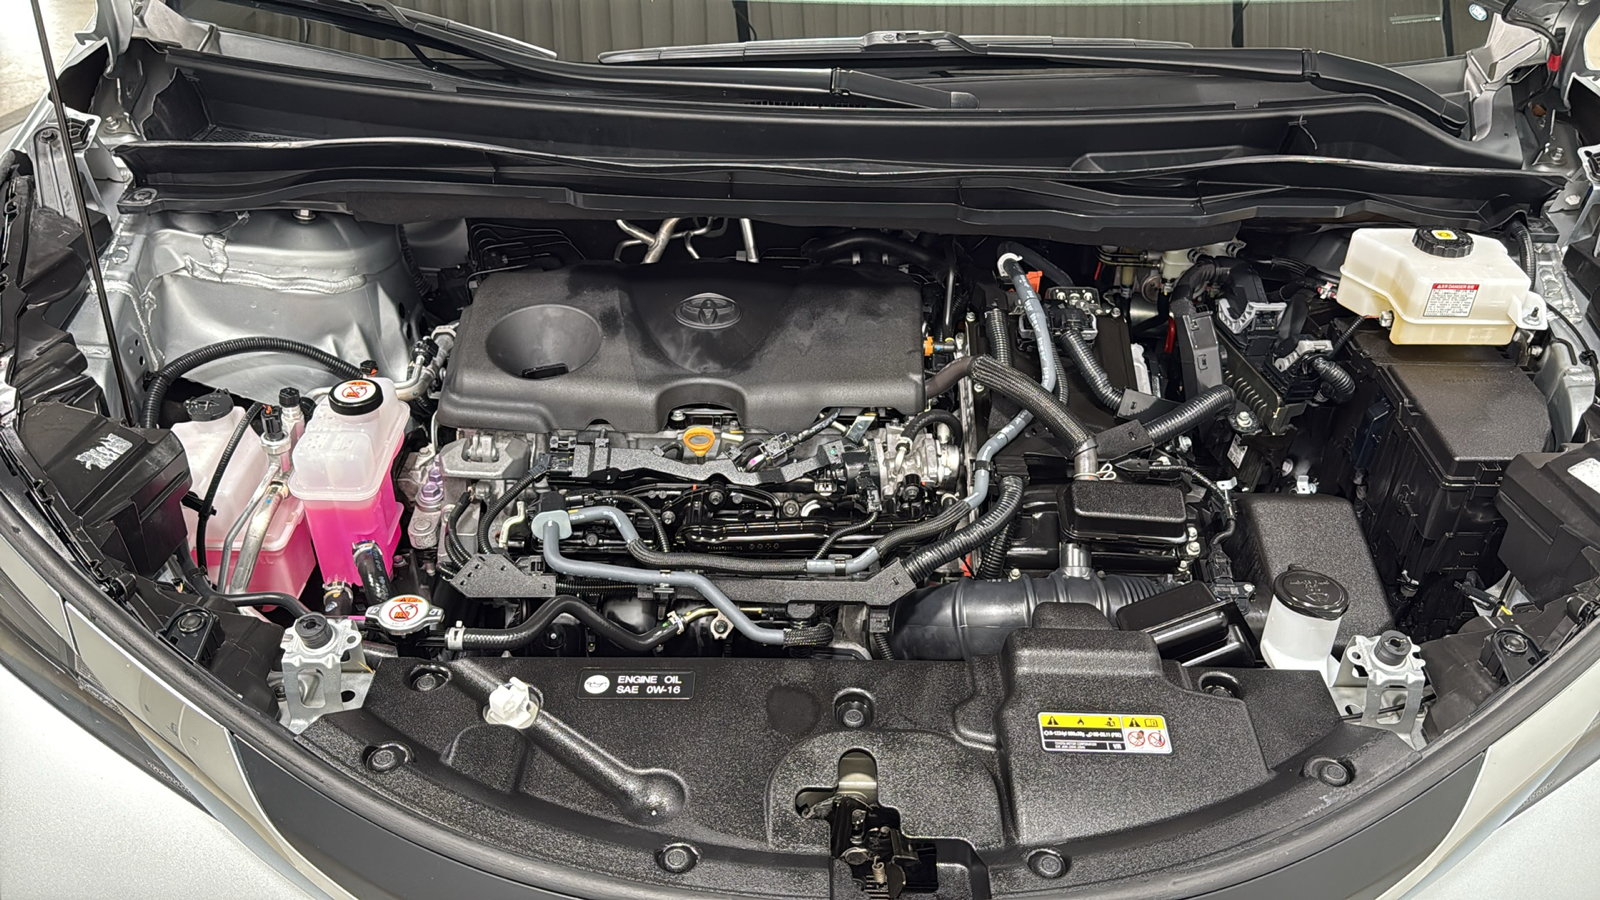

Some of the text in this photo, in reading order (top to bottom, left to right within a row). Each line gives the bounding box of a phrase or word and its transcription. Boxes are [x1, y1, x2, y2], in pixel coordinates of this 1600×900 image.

[617, 675, 682, 684] ENGINE OIL
[616, 686, 681, 694] SAE 0W-16
